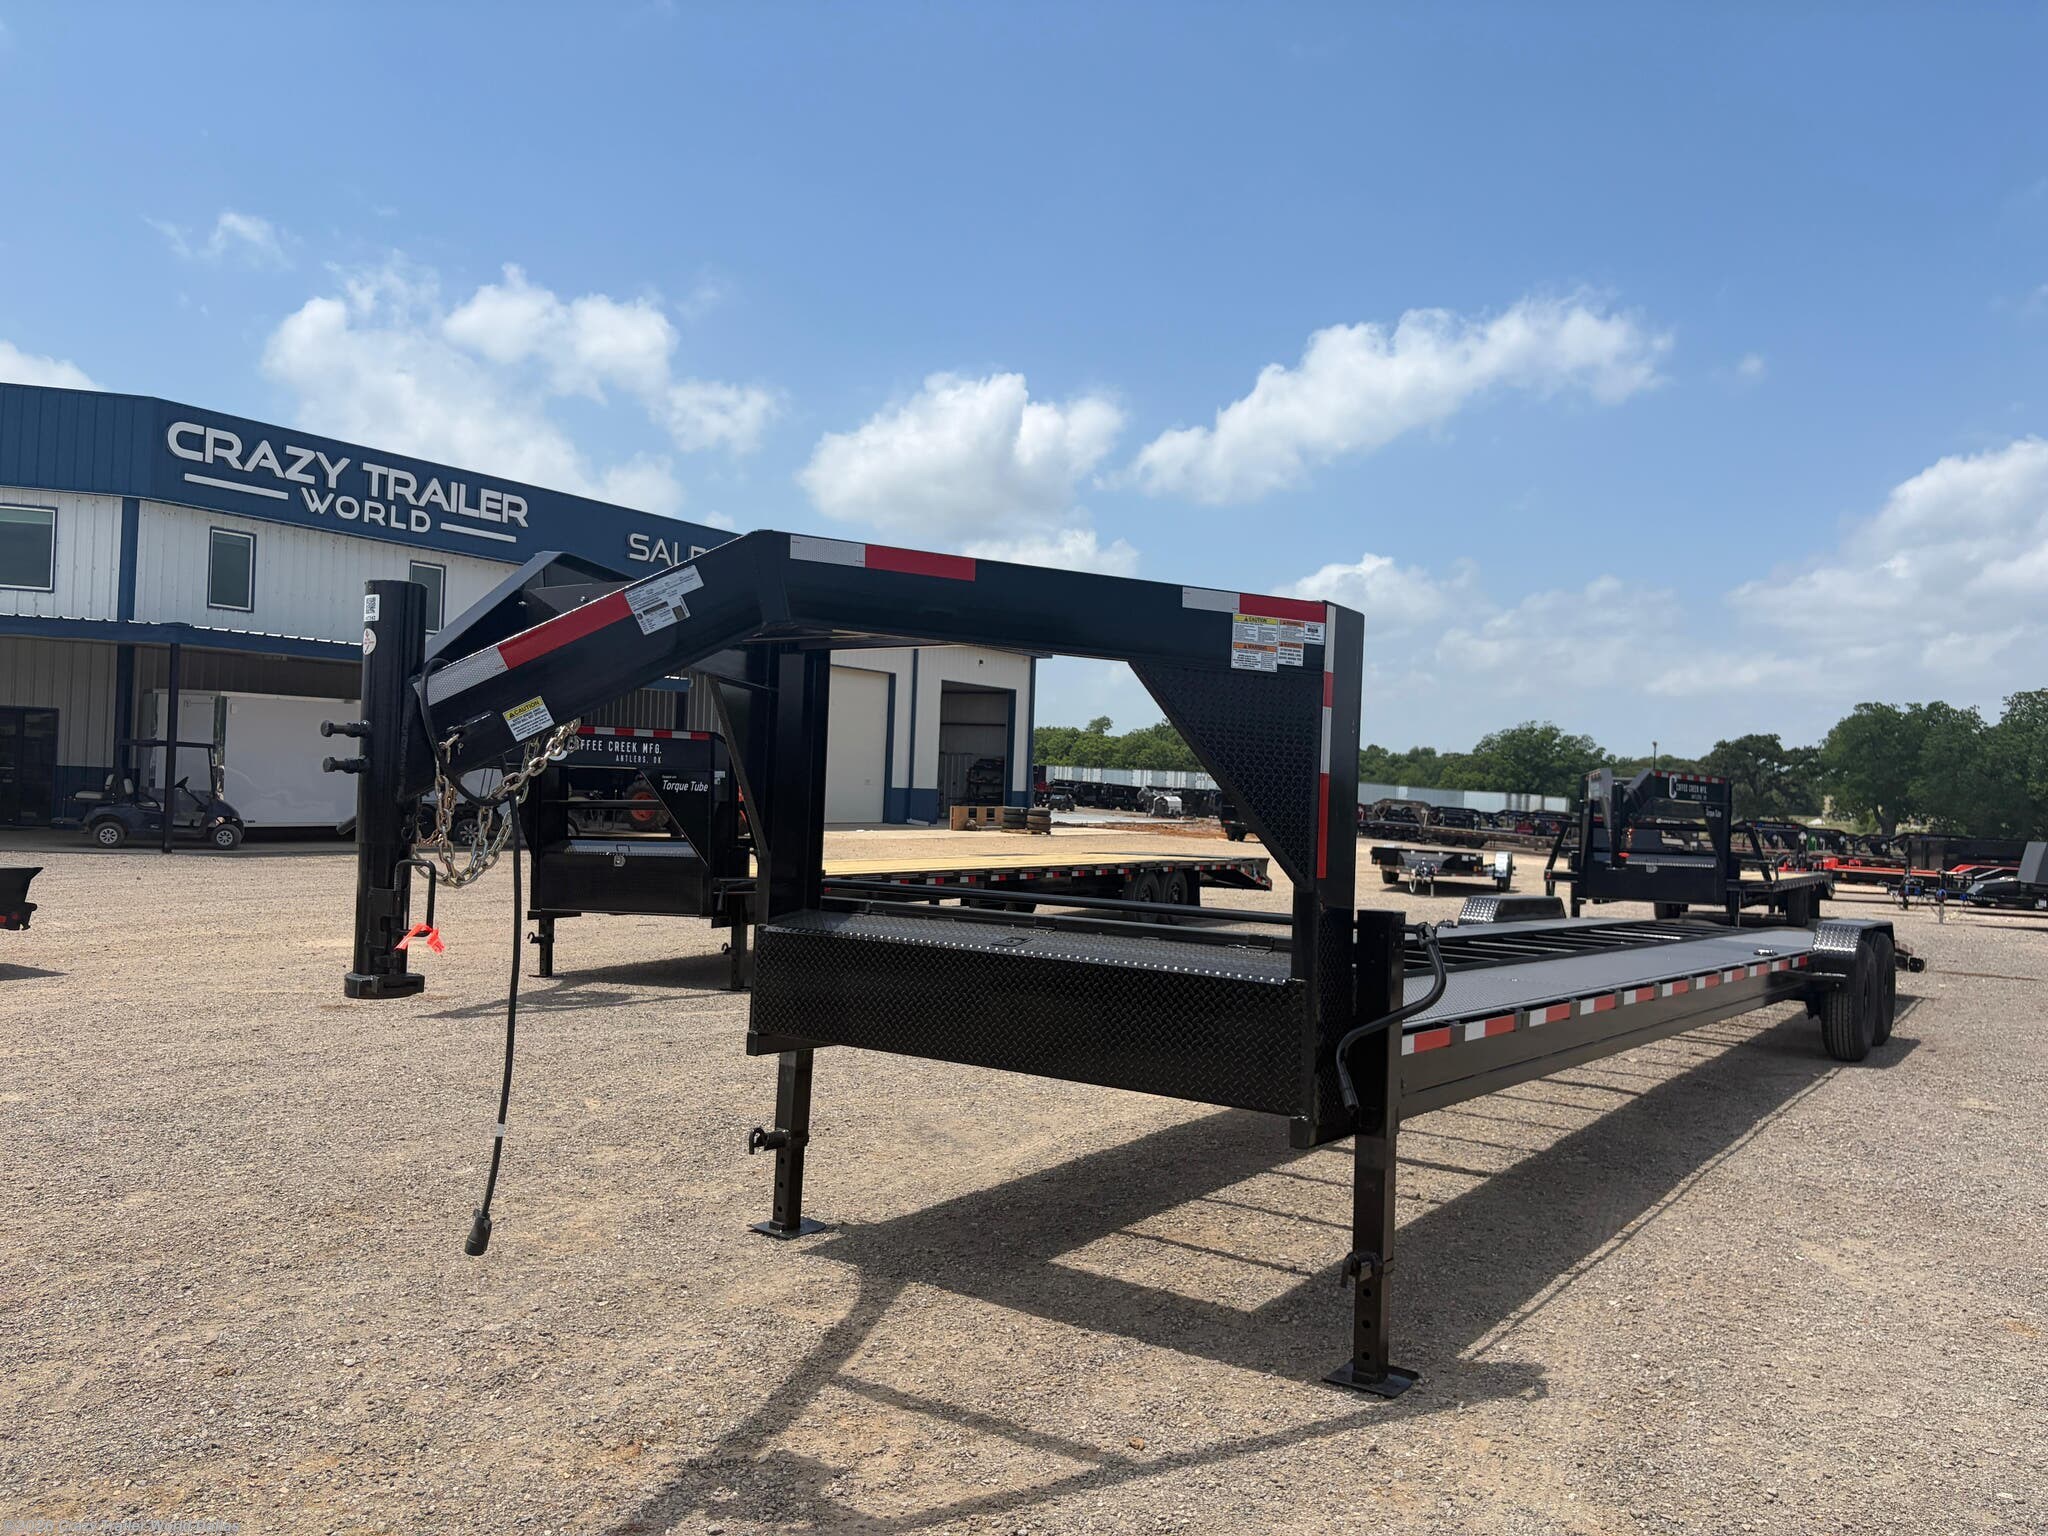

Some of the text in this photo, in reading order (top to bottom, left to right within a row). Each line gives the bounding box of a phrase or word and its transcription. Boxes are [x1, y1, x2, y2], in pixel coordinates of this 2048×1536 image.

[167, 421, 529, 528] CRAZY TRAILER
[301, 487, 431, 533] WORLD
[514, 700, 541, 715] CAUTION
[608, 741, 637, 752] CREEK
[643, 743, 662, 754] MFG.
[663, 780, 709, 792] Torque Tube
